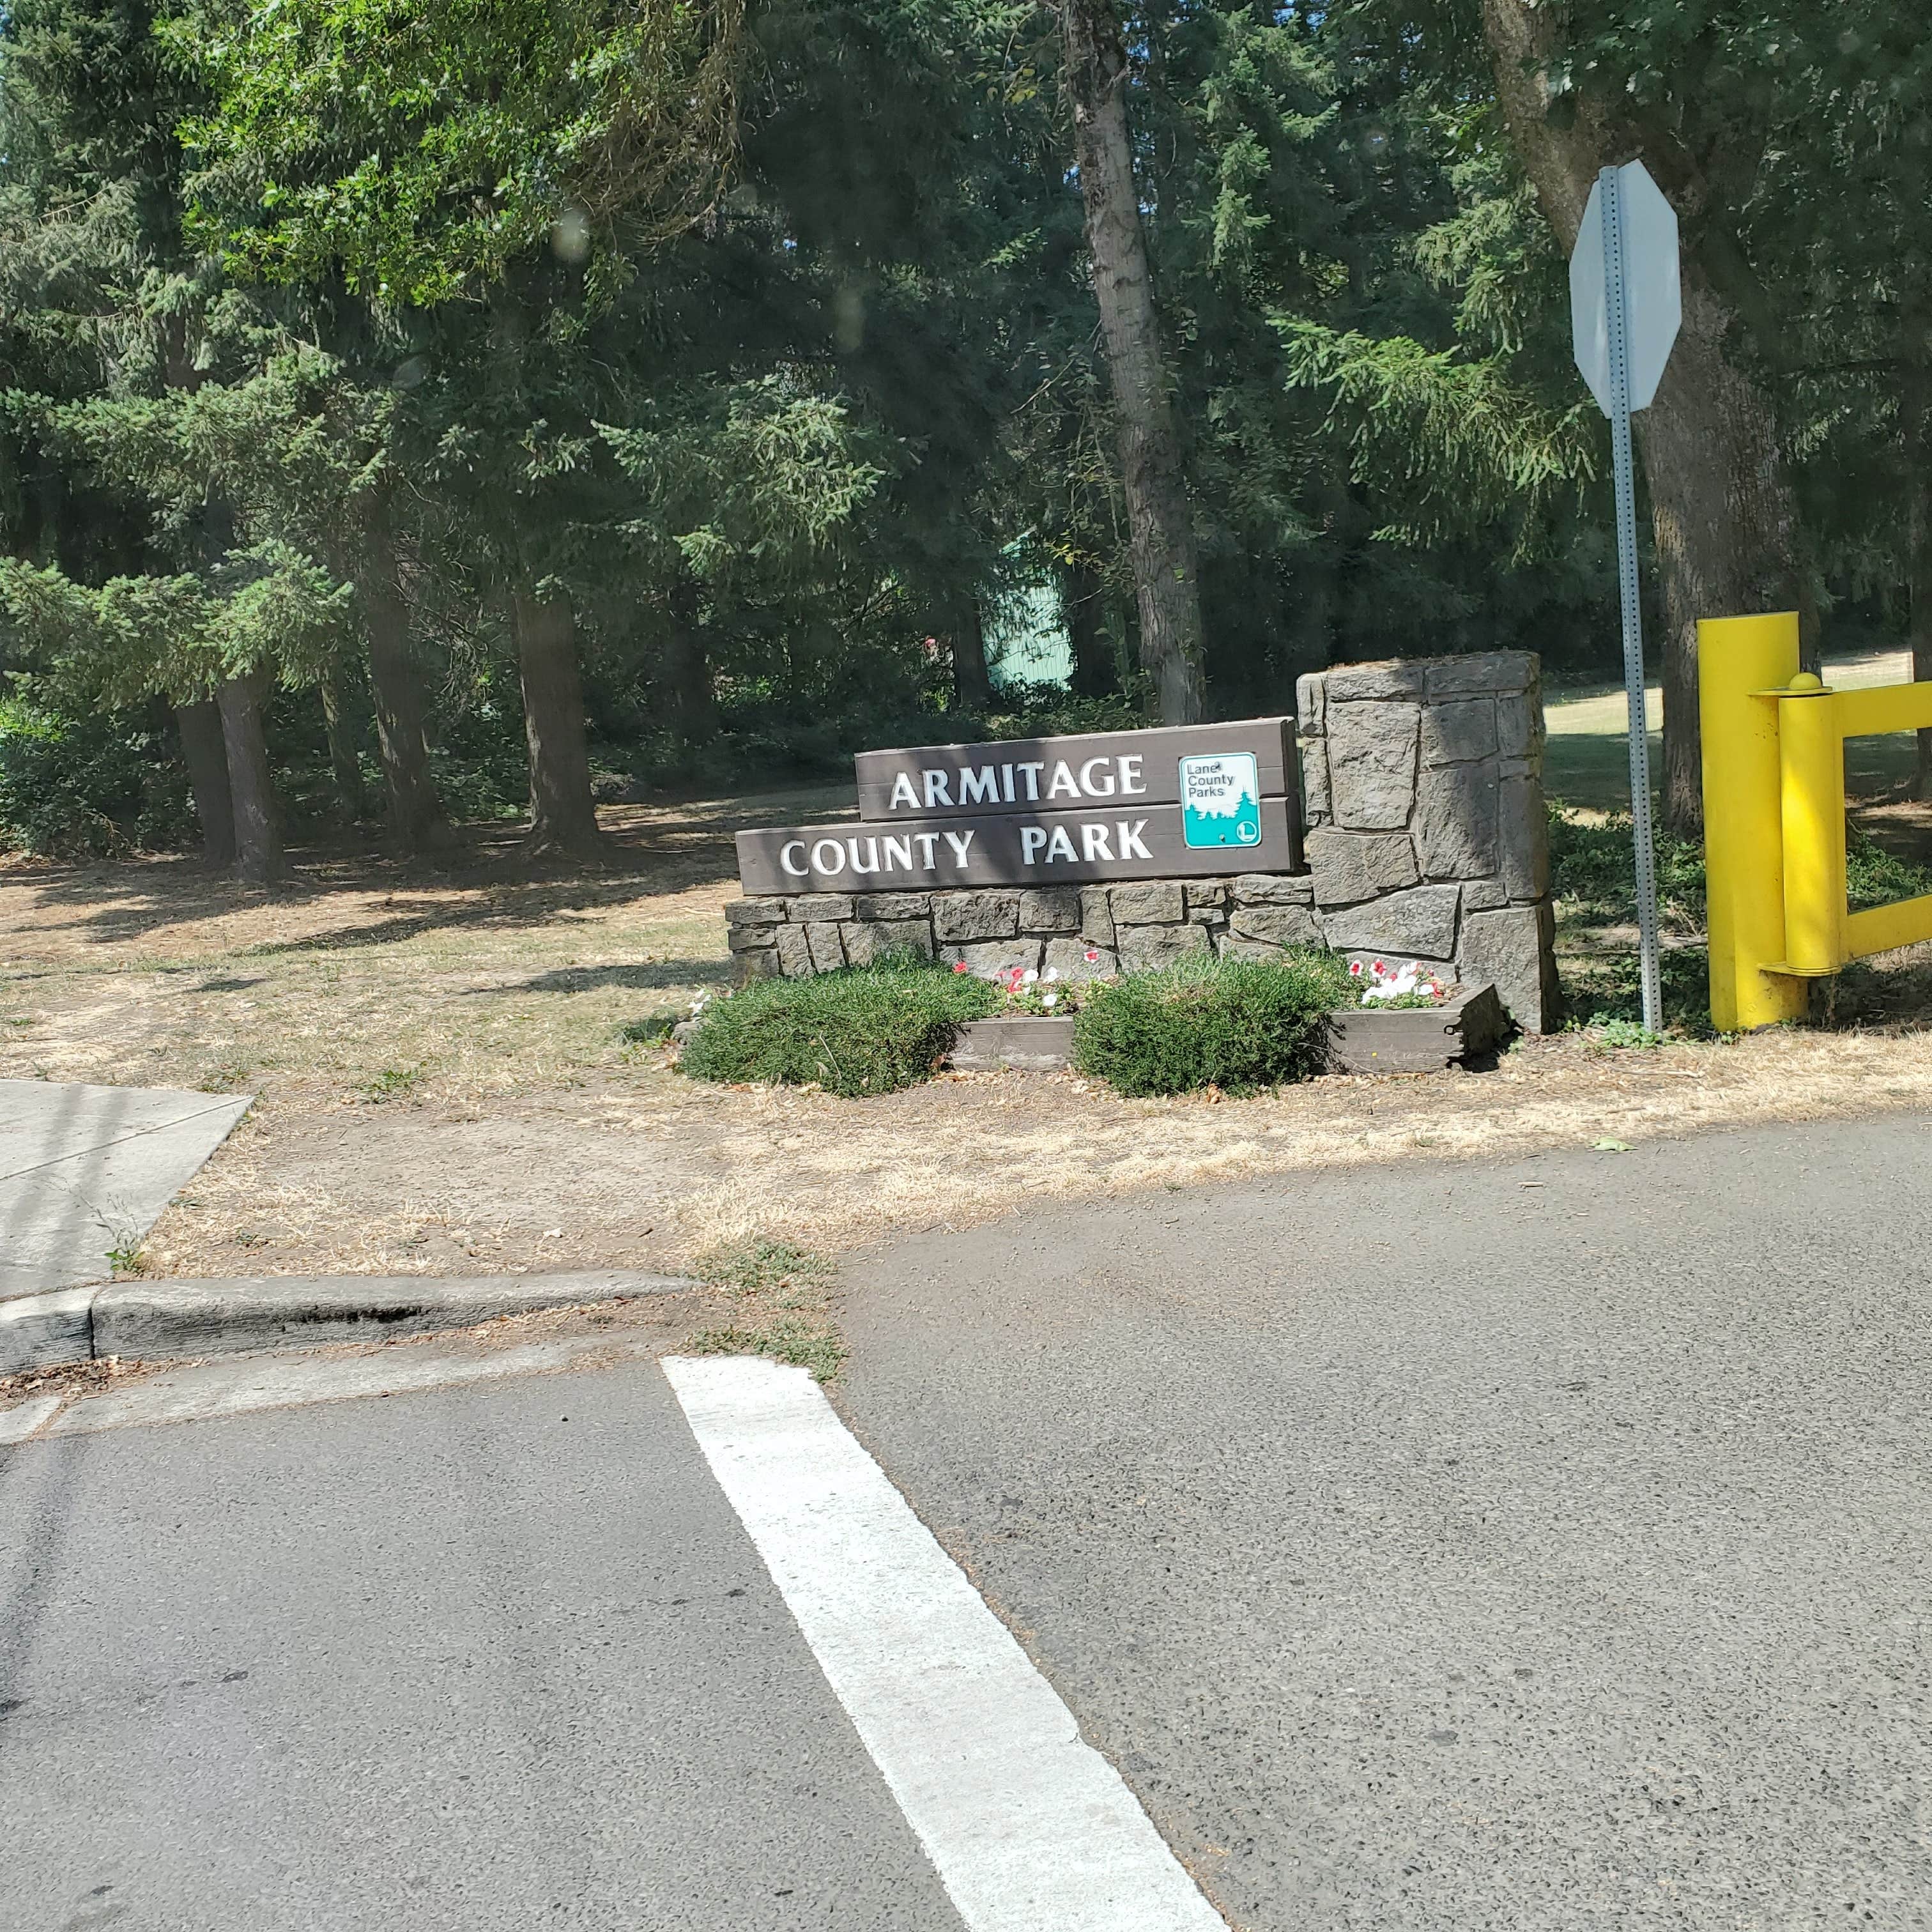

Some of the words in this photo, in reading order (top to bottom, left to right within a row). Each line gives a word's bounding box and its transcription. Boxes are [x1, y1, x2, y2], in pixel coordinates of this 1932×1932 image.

[1187, 764, 1217, 774] Lane
[889, 753, 1147, 810] ARMITAGE
[1188, 774, 1234, 786] County
[1189, 786, 1224, 797] Parks
[779, 829, 976, 876] COUNTY
[1020, 818, 1154, 866] PARK
